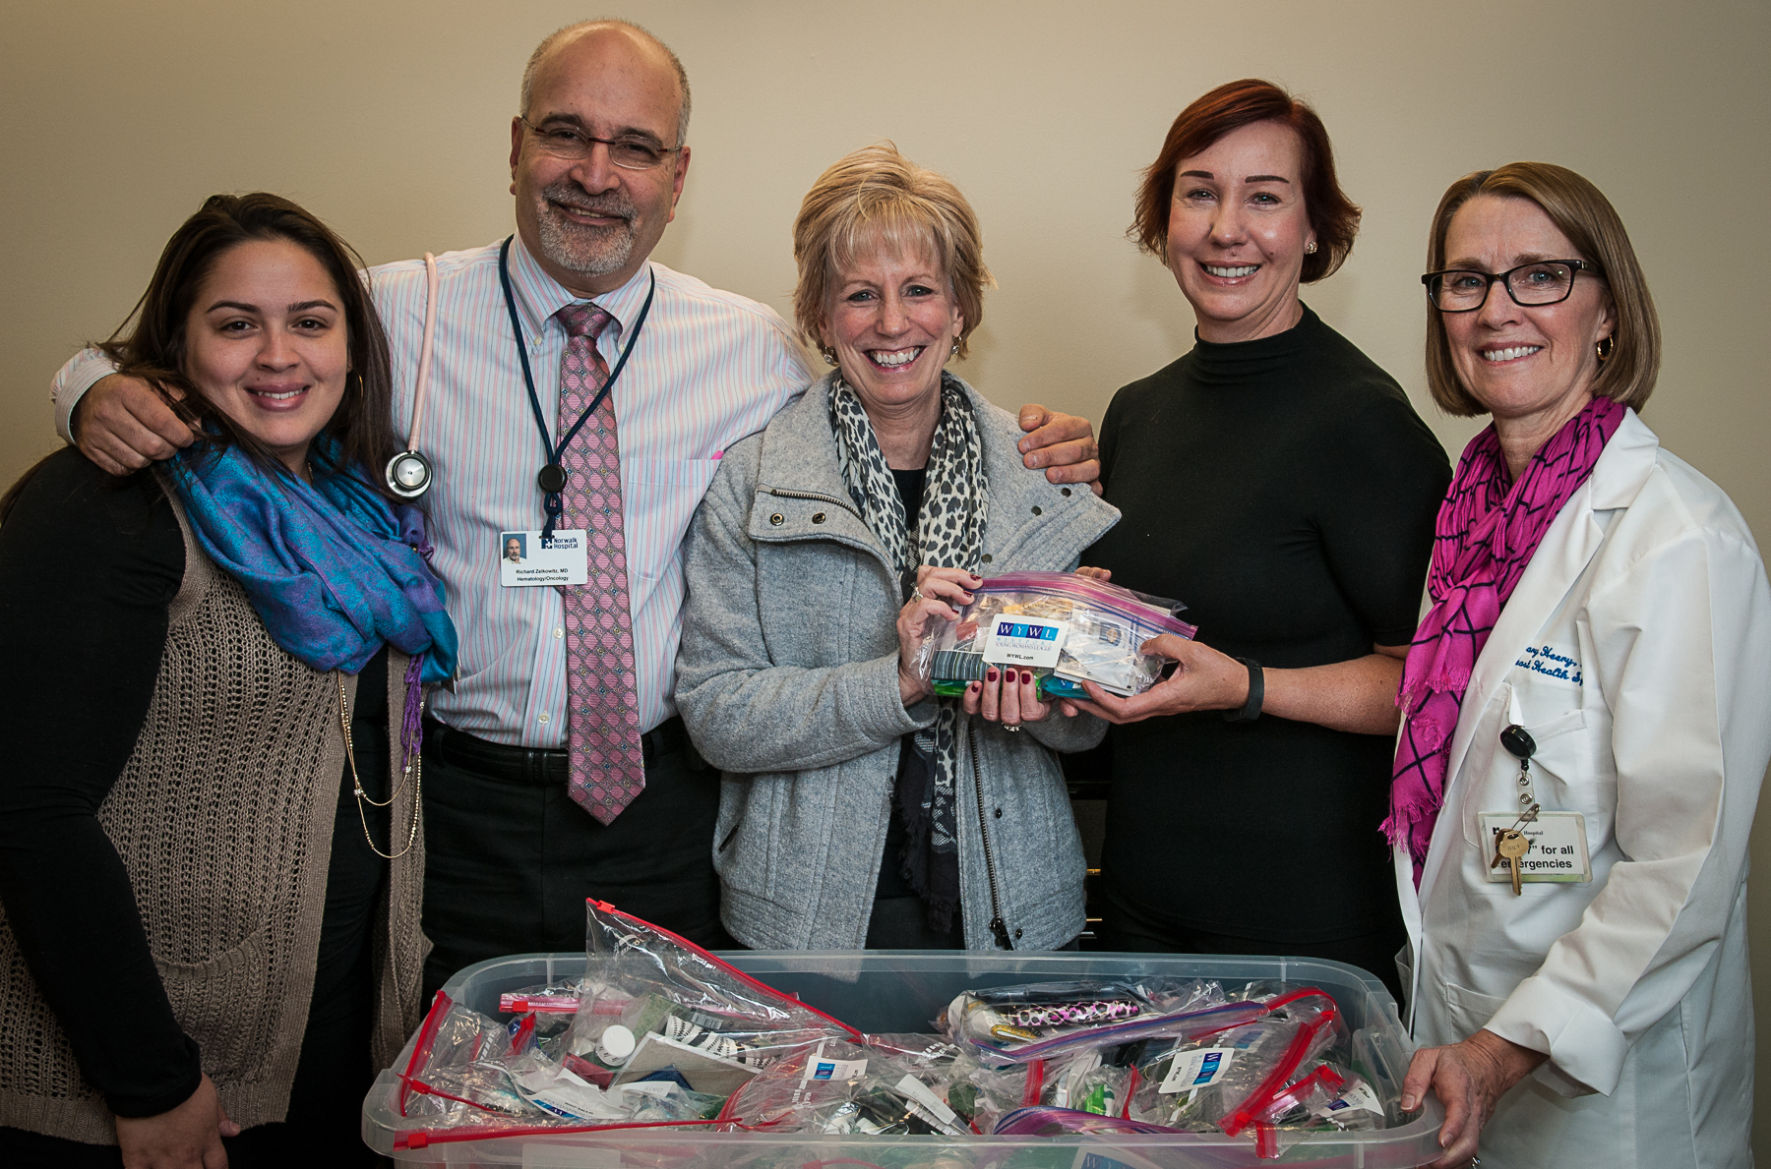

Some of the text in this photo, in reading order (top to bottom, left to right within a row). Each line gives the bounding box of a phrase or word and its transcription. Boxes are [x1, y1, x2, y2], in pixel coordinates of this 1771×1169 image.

[999, 623, 1055, 640] WYWL
[1541, 845, 1557, 854] for
[1560, 845, 1574, 854] all
